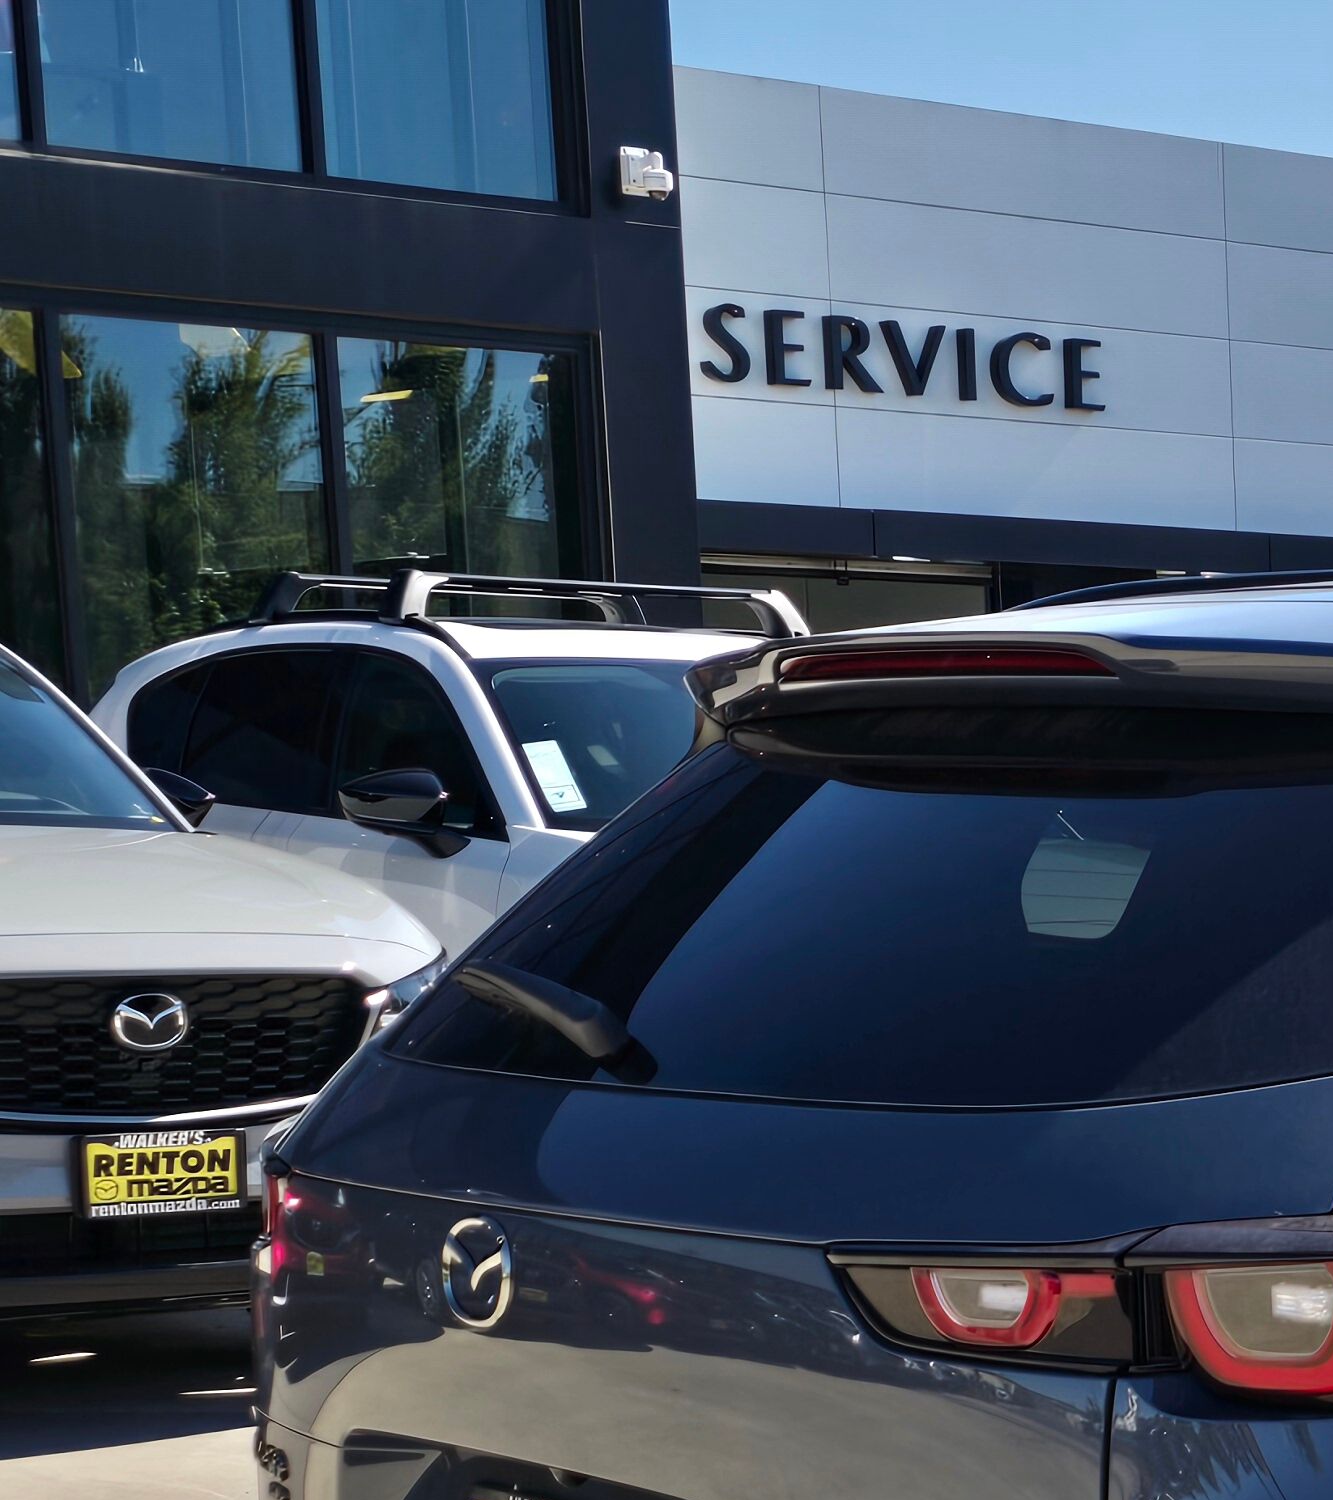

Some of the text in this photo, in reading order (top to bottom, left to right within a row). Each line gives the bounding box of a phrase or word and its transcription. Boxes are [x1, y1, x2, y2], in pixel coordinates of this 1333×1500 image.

[700, 303, 1106, 411] SERVICE
[119, 1131, 206, 1148] WALKER'S
[94, 1149, 231, 1177] RENTON
[127, 1176, 229, 1197] mazda
[91, 1197, 240, 1217] rentonmazda.com
